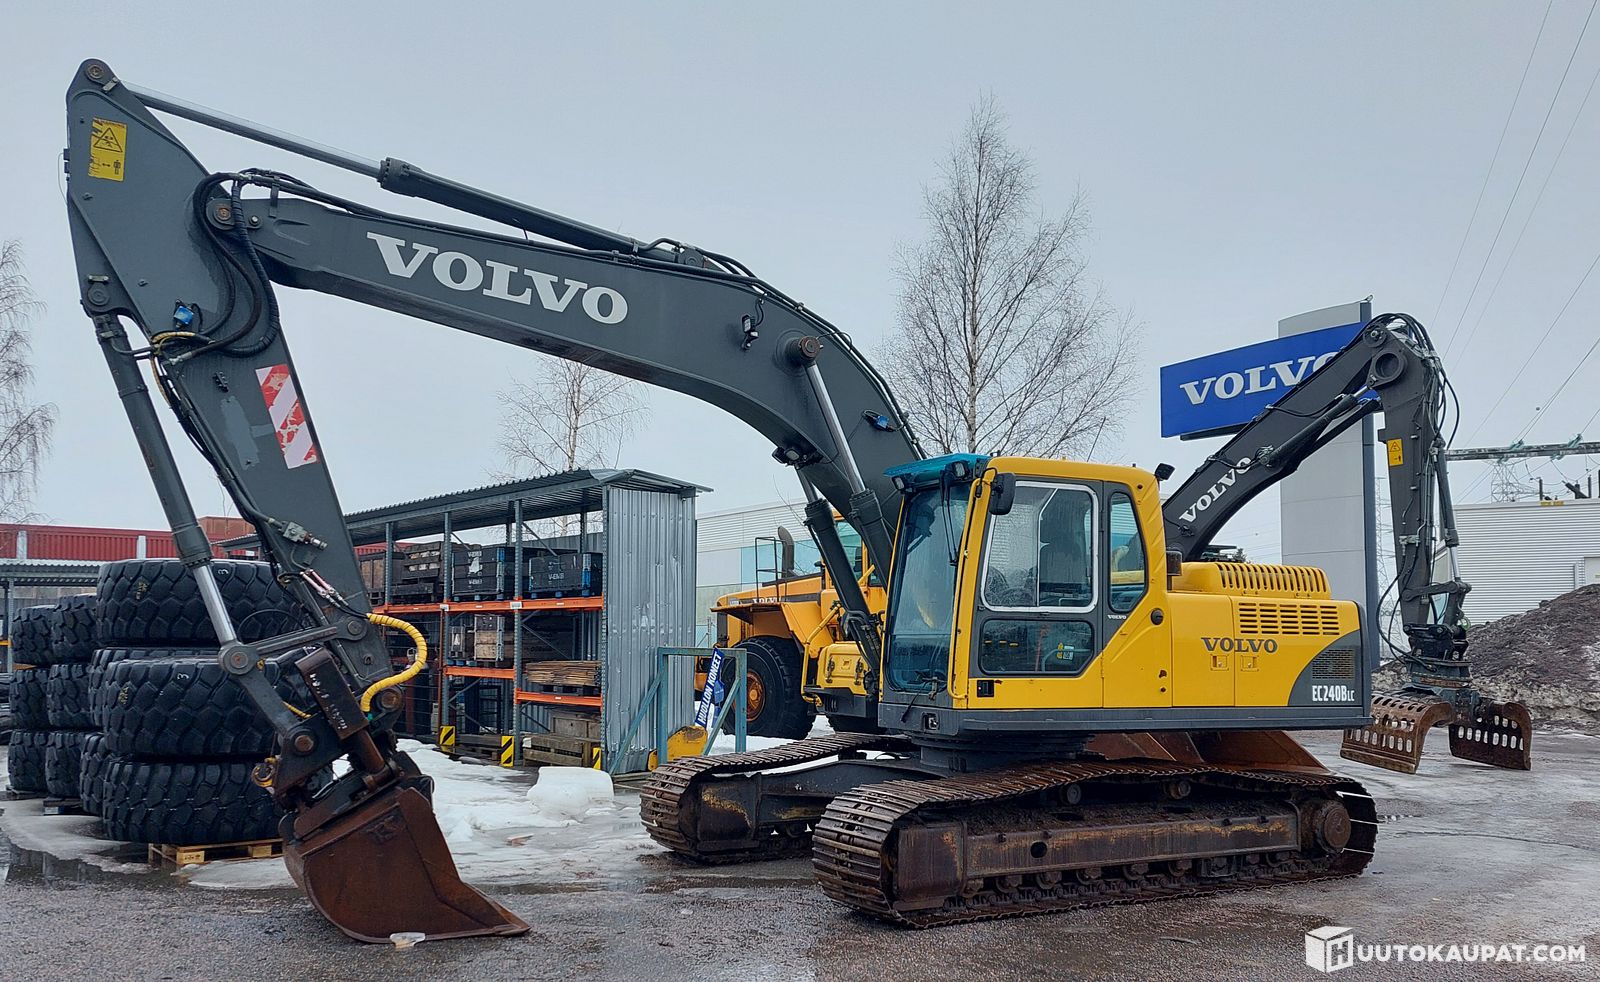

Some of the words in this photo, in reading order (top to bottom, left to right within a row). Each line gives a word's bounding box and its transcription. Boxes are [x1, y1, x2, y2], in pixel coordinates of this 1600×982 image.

[366, 231, 628, 324] VOLVO
[1179, 457, 1252, 523] VOLVO
[707, 652, 722, 686] KONEET
[1200, 637, 1278, 653] VOLVO
